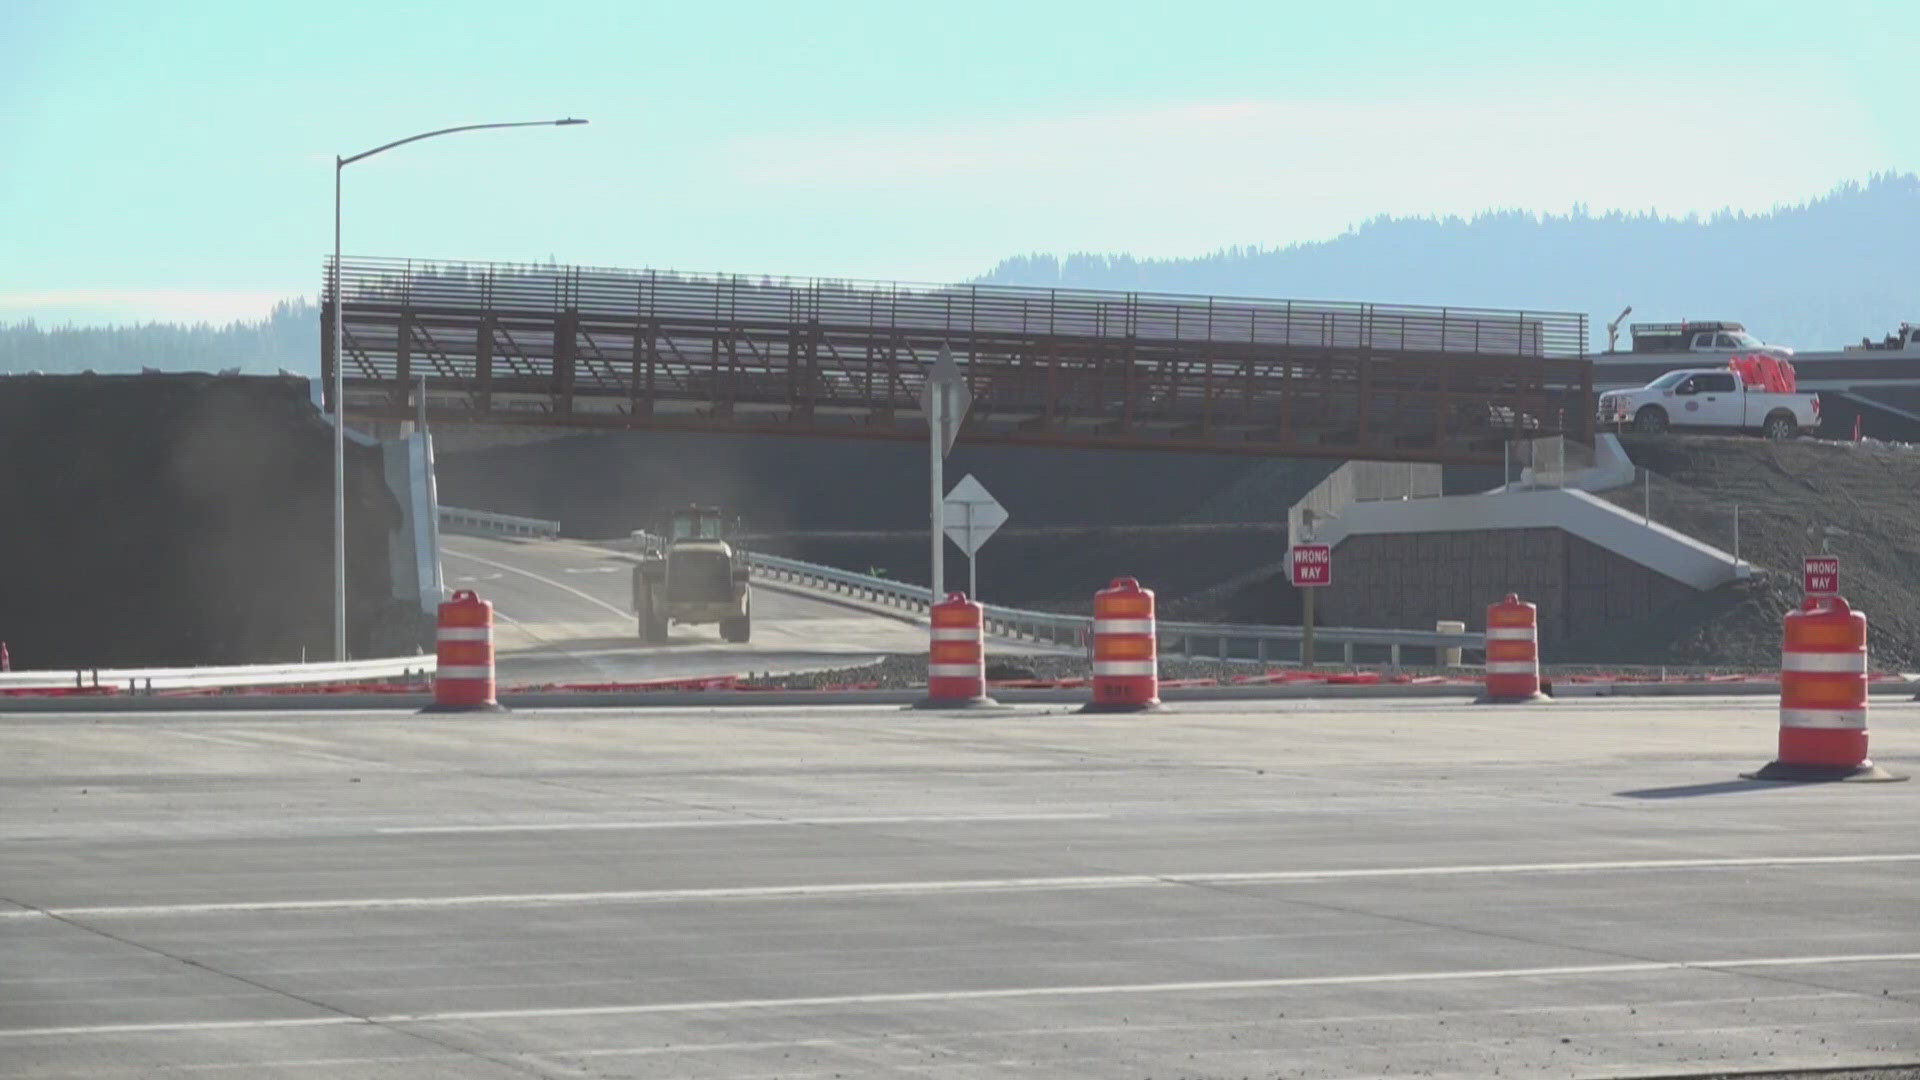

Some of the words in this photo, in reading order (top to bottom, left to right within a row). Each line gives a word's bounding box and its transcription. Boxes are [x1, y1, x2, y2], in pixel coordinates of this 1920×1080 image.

[1294, 550, 1328, 563] WRONG
[1301, 566, 1321, 579] WAY
[1806, 561, 1836, 575] WRONG
[1811, 577, 1830, 589] WAY
